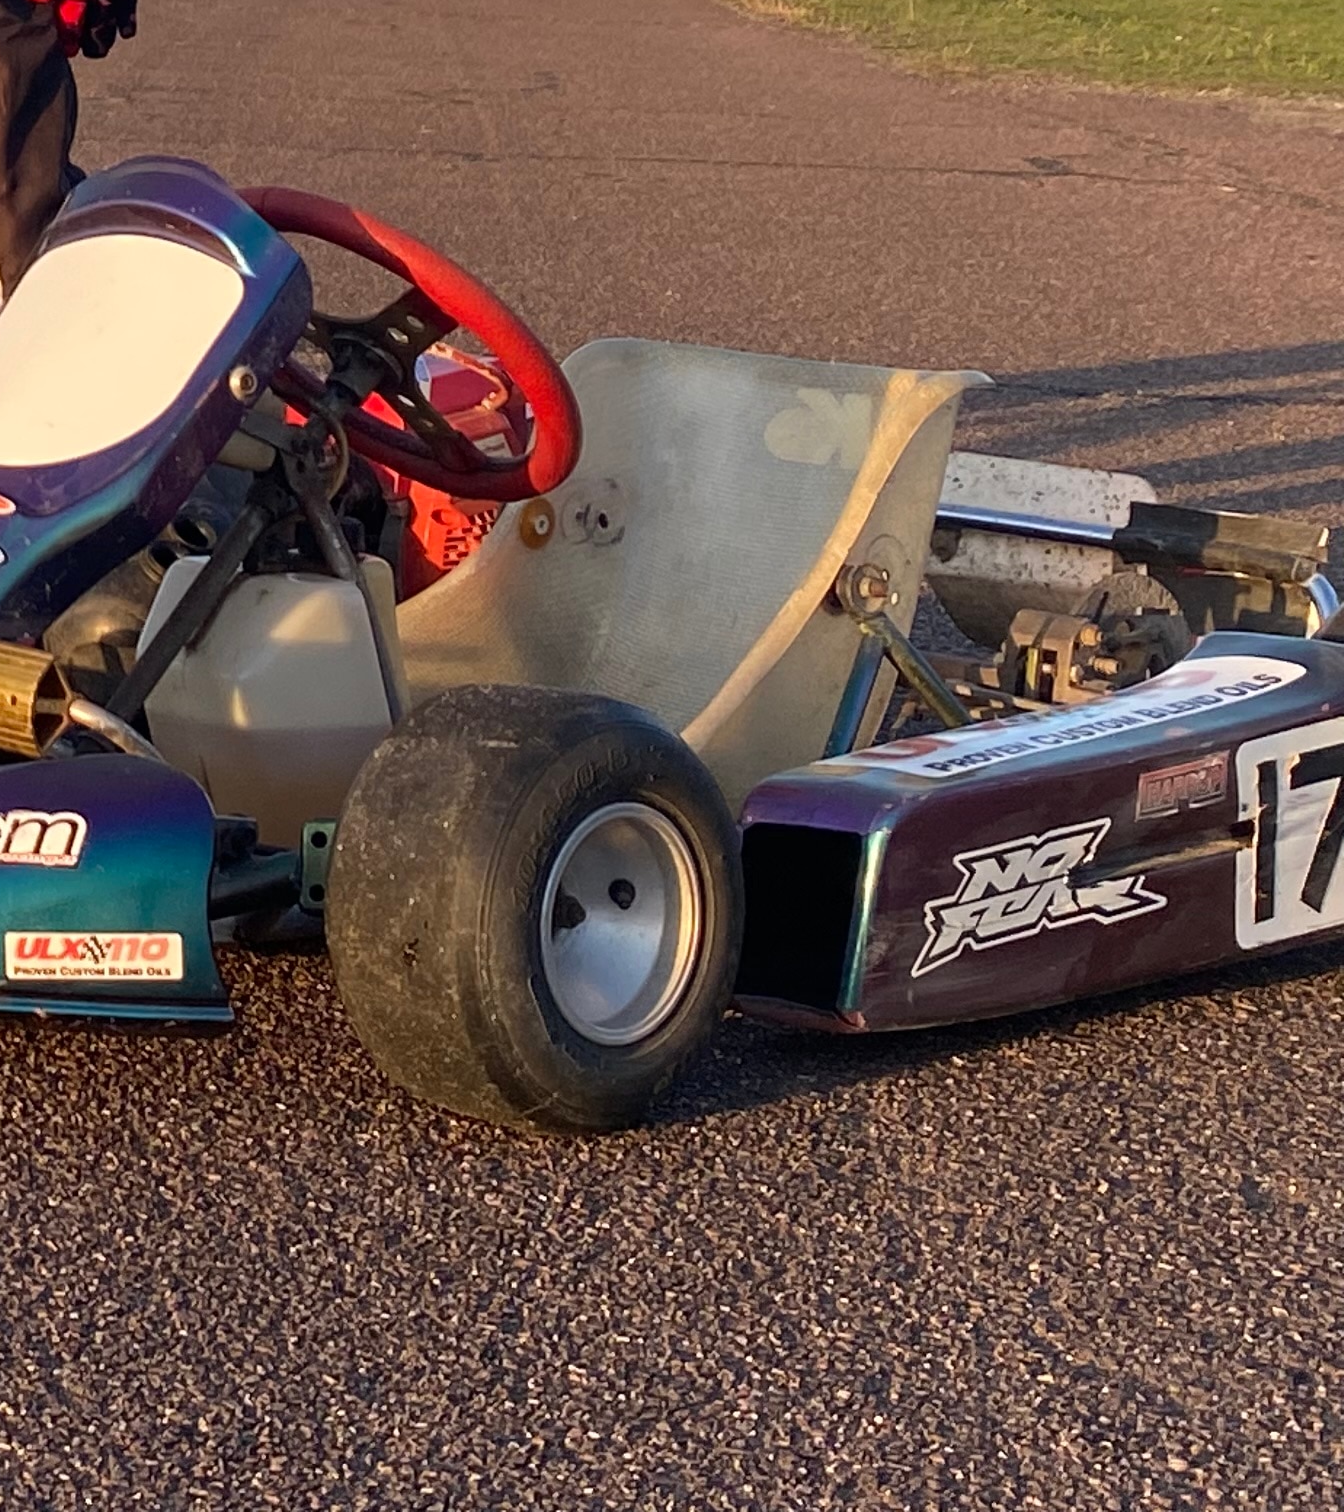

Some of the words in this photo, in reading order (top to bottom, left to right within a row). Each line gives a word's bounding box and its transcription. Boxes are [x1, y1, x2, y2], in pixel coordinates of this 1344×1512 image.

[924, 740, 1029, 774] PROVEN
[1030, 713, 1142, 747] CUSTOM
[1143, 691, 1222, 722] BLEND
[1222, 673, 1283, 698] OILS
[14, 937, 85, 962] ULX
[110, 937, 170, 962] 110
